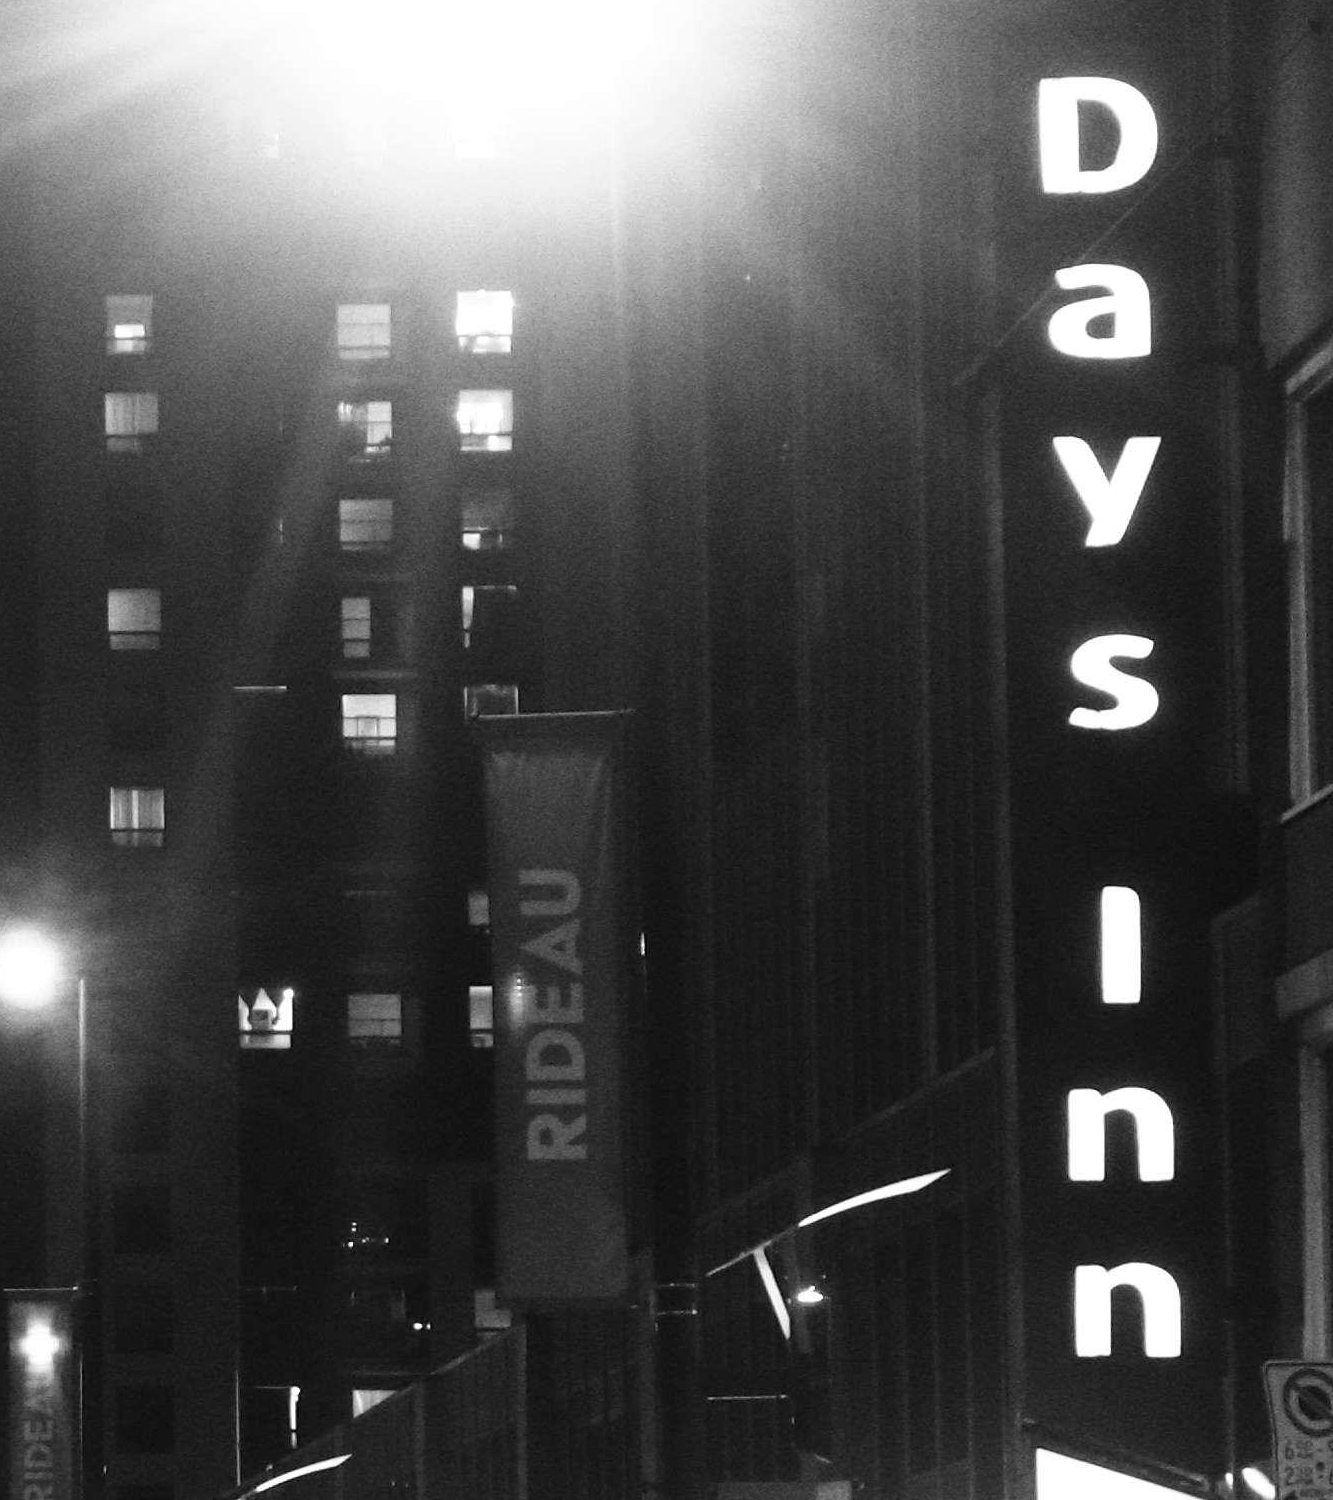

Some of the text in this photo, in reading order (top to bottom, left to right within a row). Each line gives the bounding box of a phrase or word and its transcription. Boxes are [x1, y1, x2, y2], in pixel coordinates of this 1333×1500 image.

[517, 867, 588, 1162] RIDEAU
[1037, 75, 1182, 1358] Days Inn
